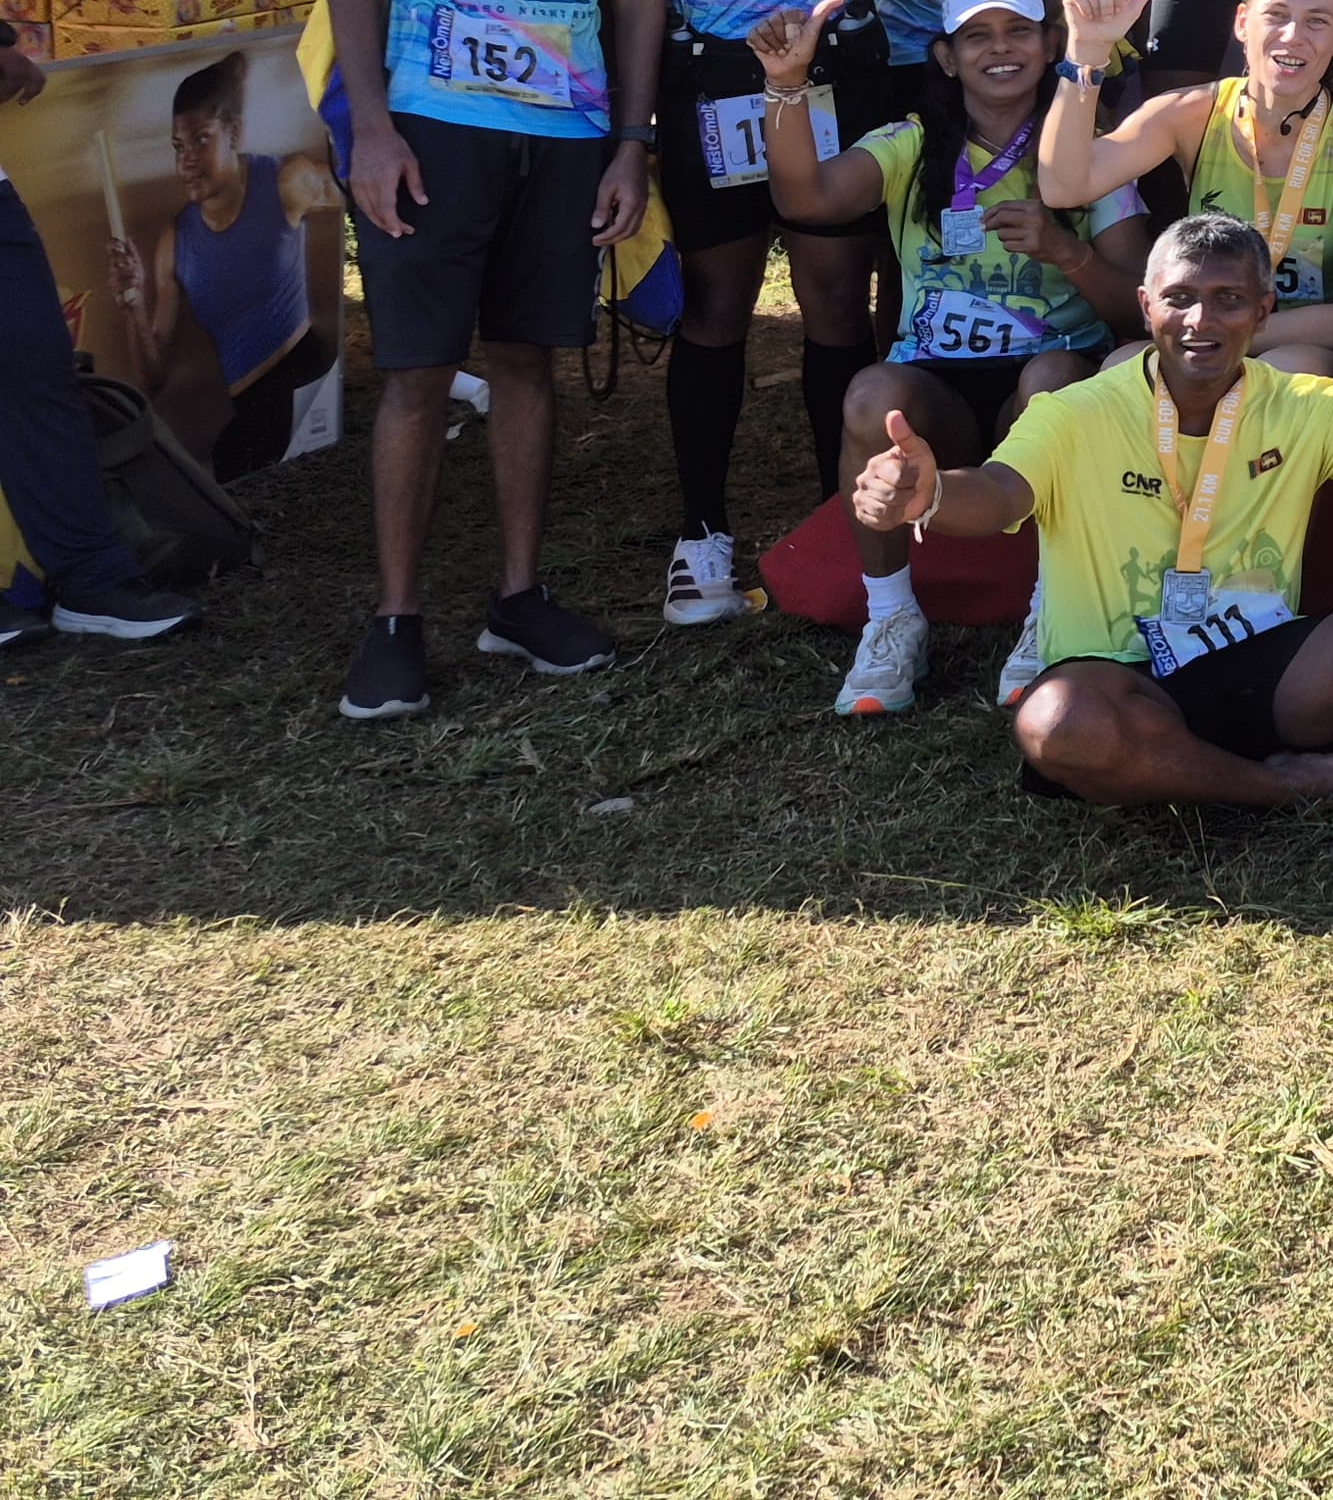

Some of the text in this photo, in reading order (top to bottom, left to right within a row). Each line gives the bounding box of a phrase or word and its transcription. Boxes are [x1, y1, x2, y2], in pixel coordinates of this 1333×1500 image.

[463, 36, 537, 84] 152
[1289, 123, 1320, 189] RUN FOR SRI
[940, 313, 1015, 355] 561
[1158, 402, 1175, 454] RUN FOR
[1214, 390, 1240, 445] RUN FOR
[1122, 471, 1162, 494] CNR
[1193, 472, 1219, 524] 21.1 KM
[1187, 603, 1256, 652] 111
